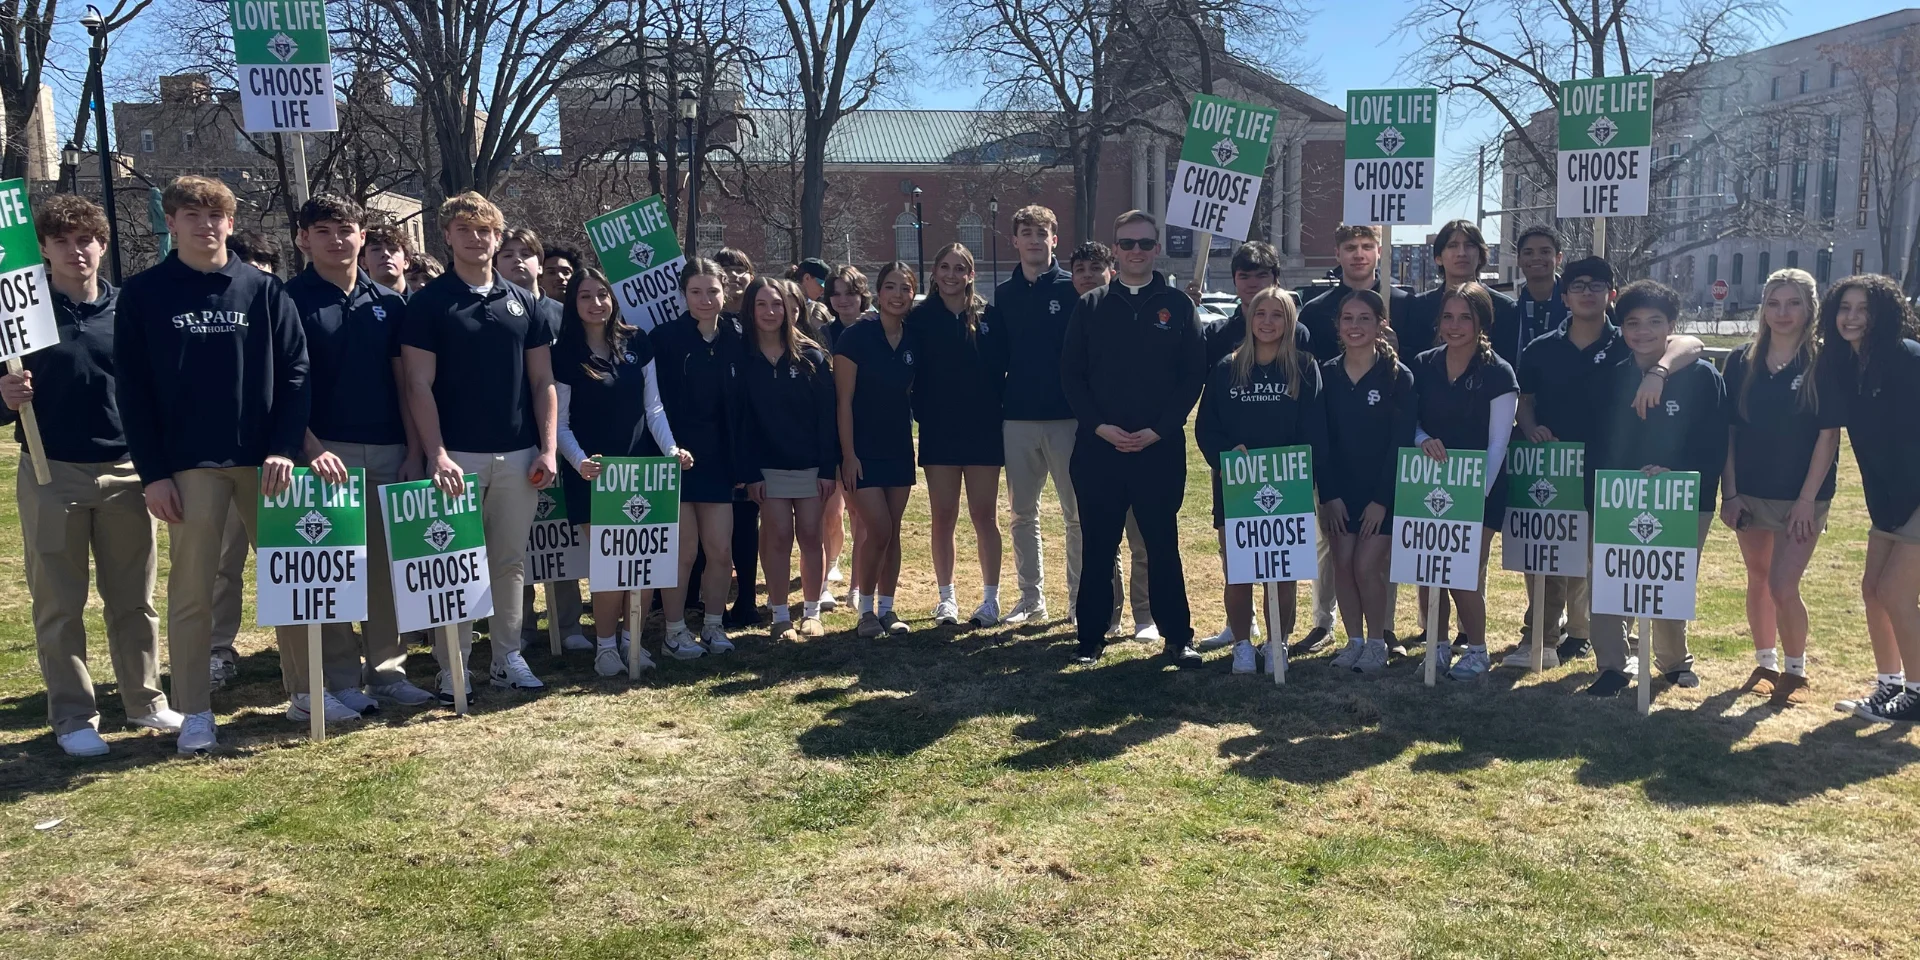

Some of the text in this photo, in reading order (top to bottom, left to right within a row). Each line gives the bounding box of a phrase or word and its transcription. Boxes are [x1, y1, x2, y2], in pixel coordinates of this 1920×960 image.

[234, 1, 322, 30] LOVE LIFE
[249, 68, 323, 96] CHOOSE
[272, 100, 310, 128] LIFE
[1351, 95, 1432, 125] LOVE LIFE
[1564, 81, 1648, 116] LOVE LIFE
[1192, 100, 1273, 143] LOVE LIFE
[1355, 161, 1424, 190] CHOOSE
[1568, 151, 1638, 182] CHOOSE
[1184, 166, 1251, 205] CHOOSE
[1584, 185, 1619, 213] LIFE
[1191, 200, 1228, 232] LIFE
[1371, 194, 1406, 222] LIFE
[592, 202, 667, 252] LOVE LIFE
[623, 262, 681, 308] CHOOSE
[1712, 286, 1728, 294] STOP
[172, 311, 249, 328] ST. PAUL
[647, 296, 680, 325] LIFE
[0, 316, 30, 357] IFE
[190, 325, 235, 333] CATHOLIC
[1230, 383, 1292, 398] ST. PAUL
[596, 464, 639, 492] LOVE
[645, 463, 676, 491] LIFE
[1226, 452, 1308, 485] LOVE LIFE
[1401, 454, 1482, 487] LOVE LIFE
[1506, 447, 1584, 477] LOVE LIFE
[321, 476, 359, 507] LIFE
[392, 487, 438, 523] LOVE
[1601, 478, 1694, 510] LOVE LIFE
[526, 522, 579, 552] HOOSE
[601, 527, 668, 556] CHOOSE
[1236, 517, 1306, 549] CHOOSE
[1402, 520, 1471, 553] CHOOSE
[1510, 511, 1577, 542] CHOOSE
[270, 550, 355, 584] CHOOSE
[406, 552, 480, 592] CHOOSE
[531, 552, 565, 580] LIFE
[618, 559, 651, 587] LIFE
[1255, 550, 1290, 579] LIFE
[1417, 554, 1451, 584] LIFE
[1525, 544, 1559, 572] LIFE
[1605, 548, 1685, 581] CHOOSE
[293, 588, 335, 620] LIFE
[428, 589, 467, 624] LIFE
[1624, 583, 1663, 614] LIFE
